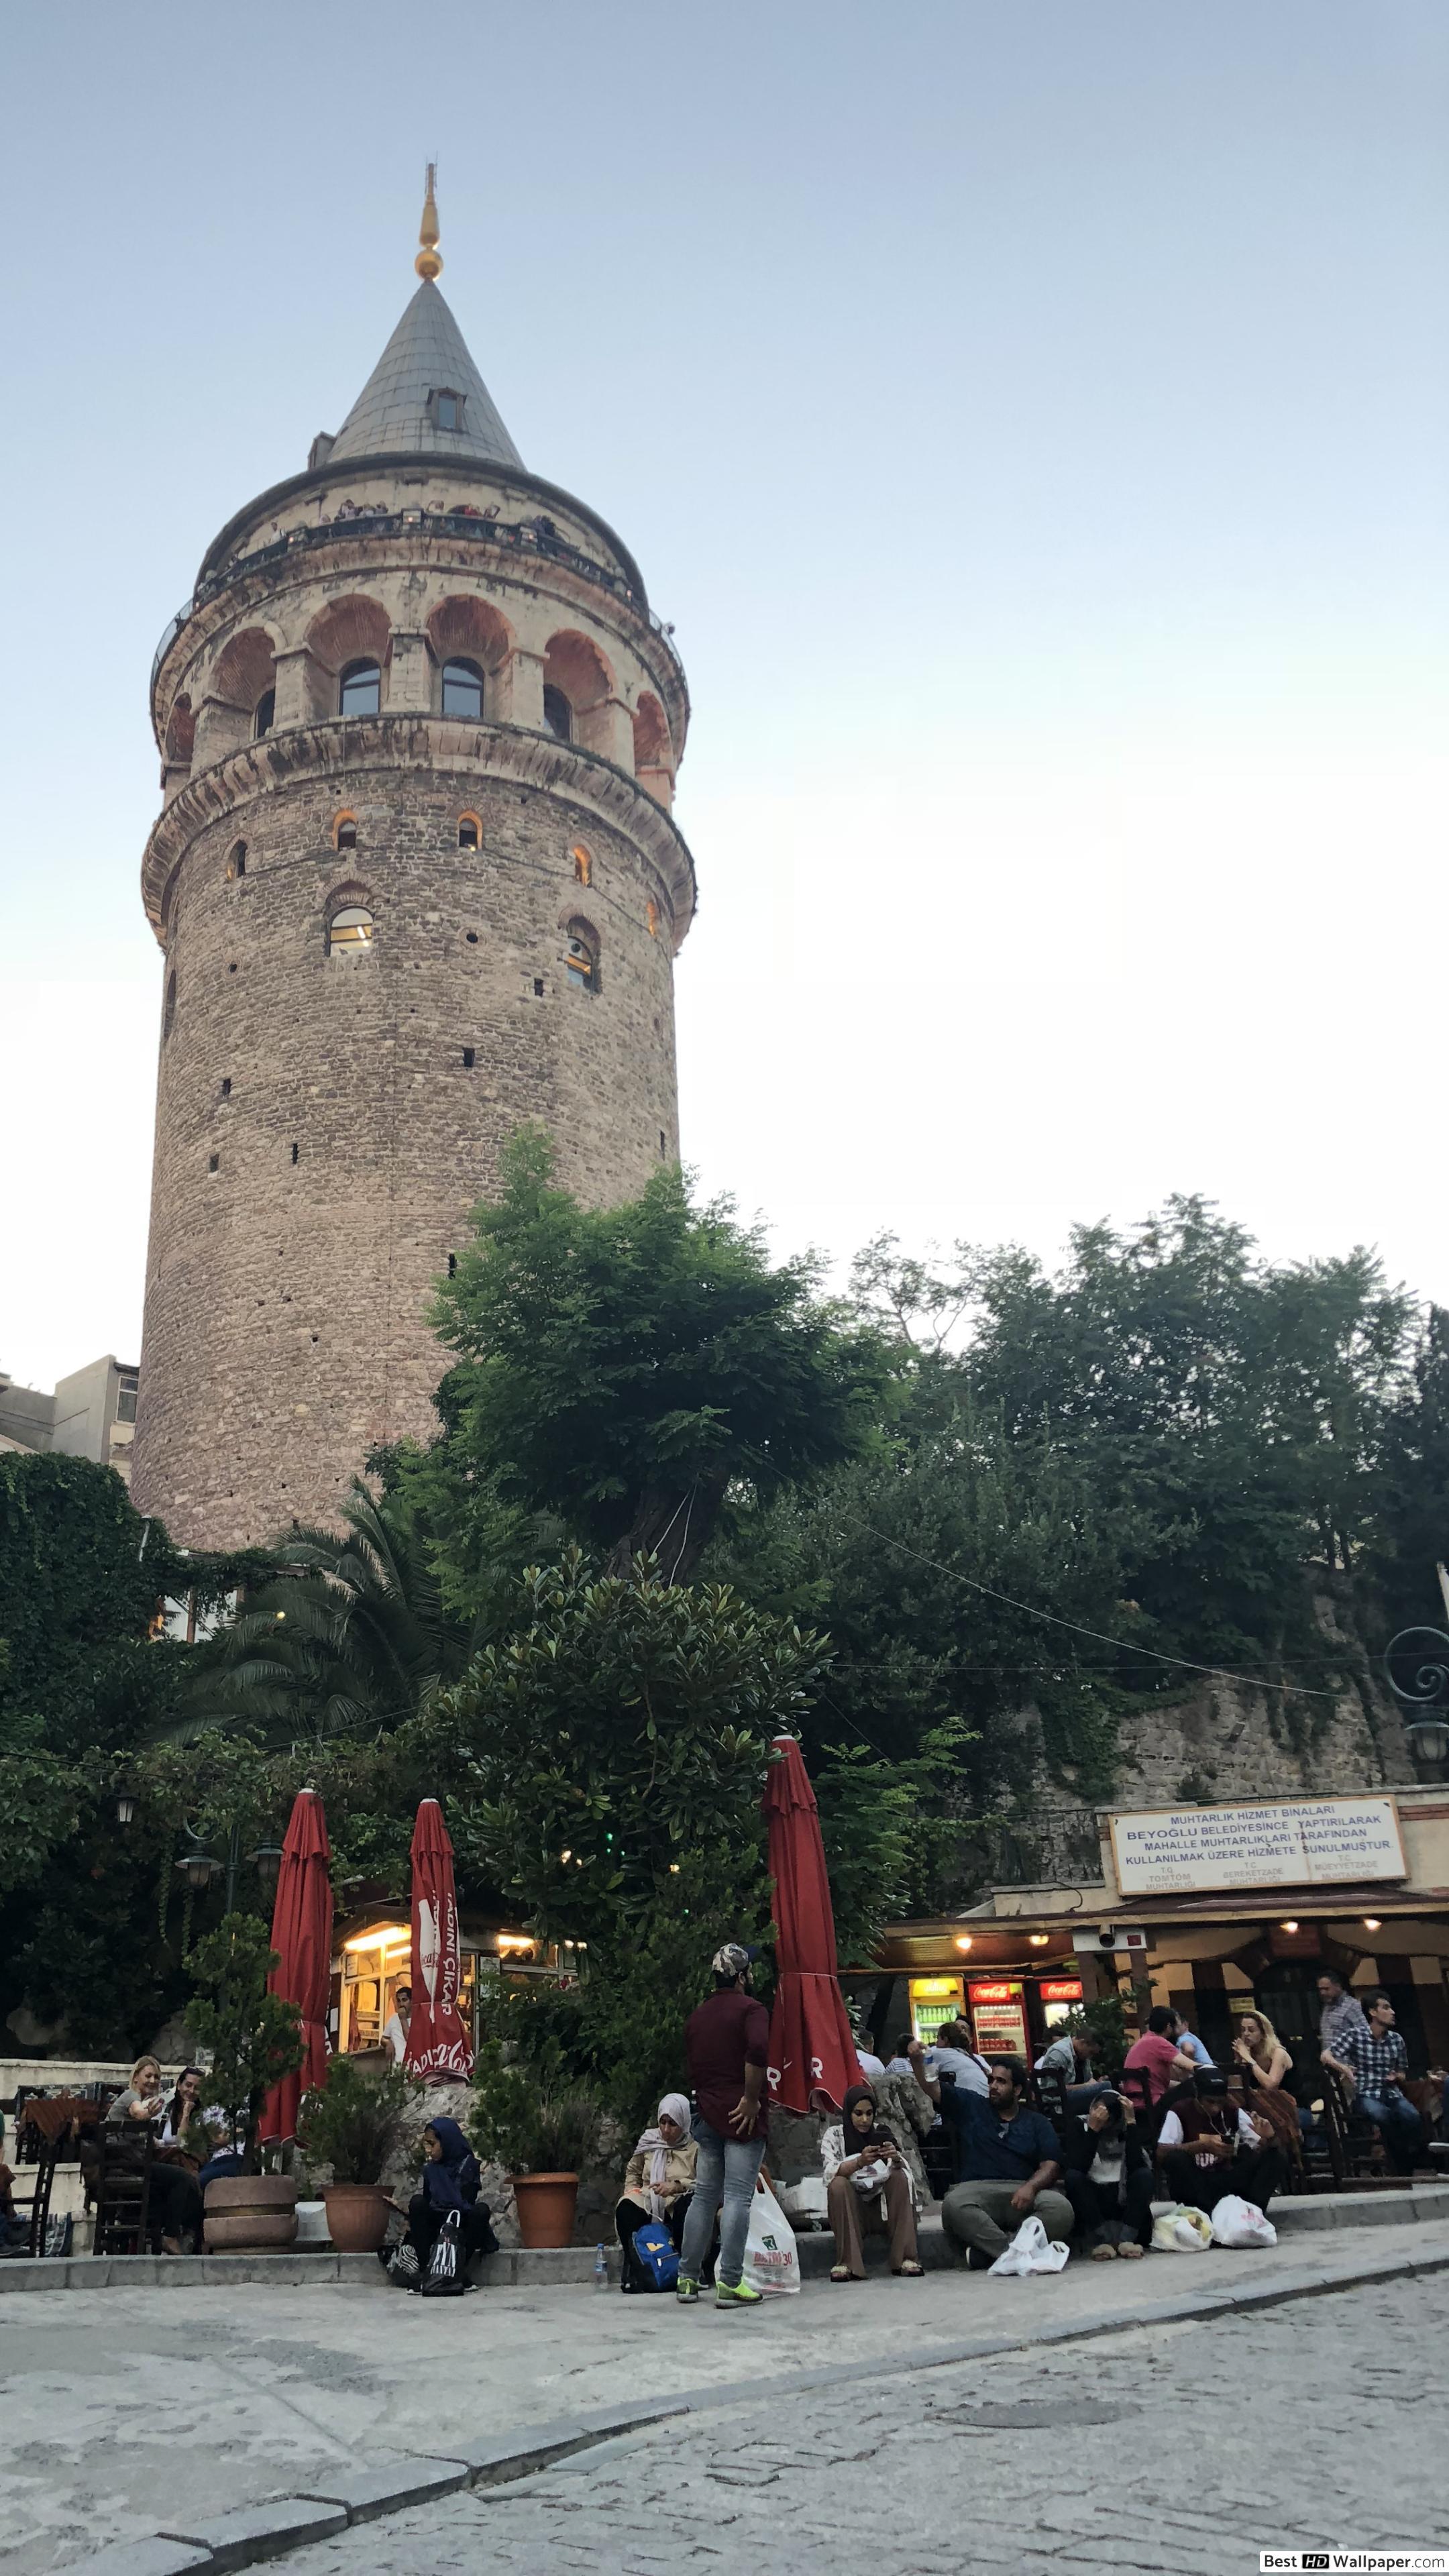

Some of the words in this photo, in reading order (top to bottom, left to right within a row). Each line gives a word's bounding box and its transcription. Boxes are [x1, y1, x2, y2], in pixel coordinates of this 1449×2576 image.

[1171, 1813, 1234, 1825] MUHTARLIK
[1237, 1809, 1277, 1820] HİZMET
[1282, 1805, 1335, 1817] BİNALARI
[1127, 1827, 1197, 1840] BEYOĞLU
[1201, 1821, 1289, 1835] BELEDİYESİNCE
[1144, 1840, 1197, 1851] MAHALLE
[1201, 1833, 1291, 1847] MUHTARLIKLARI
[1294, 1829, 1367, 1841] TARAFINDAN
[1126, 1853, 1205, 1865] KULLANILMAK
[1208, 1849, 1244, 1860] ÜZERE
[1248, 1846, 1297, 1856] HİZMETE
[1223, 1867, 1283, 1879] BEREKETZADE
[441, 1957, 455, 2016] ÇIKAR
